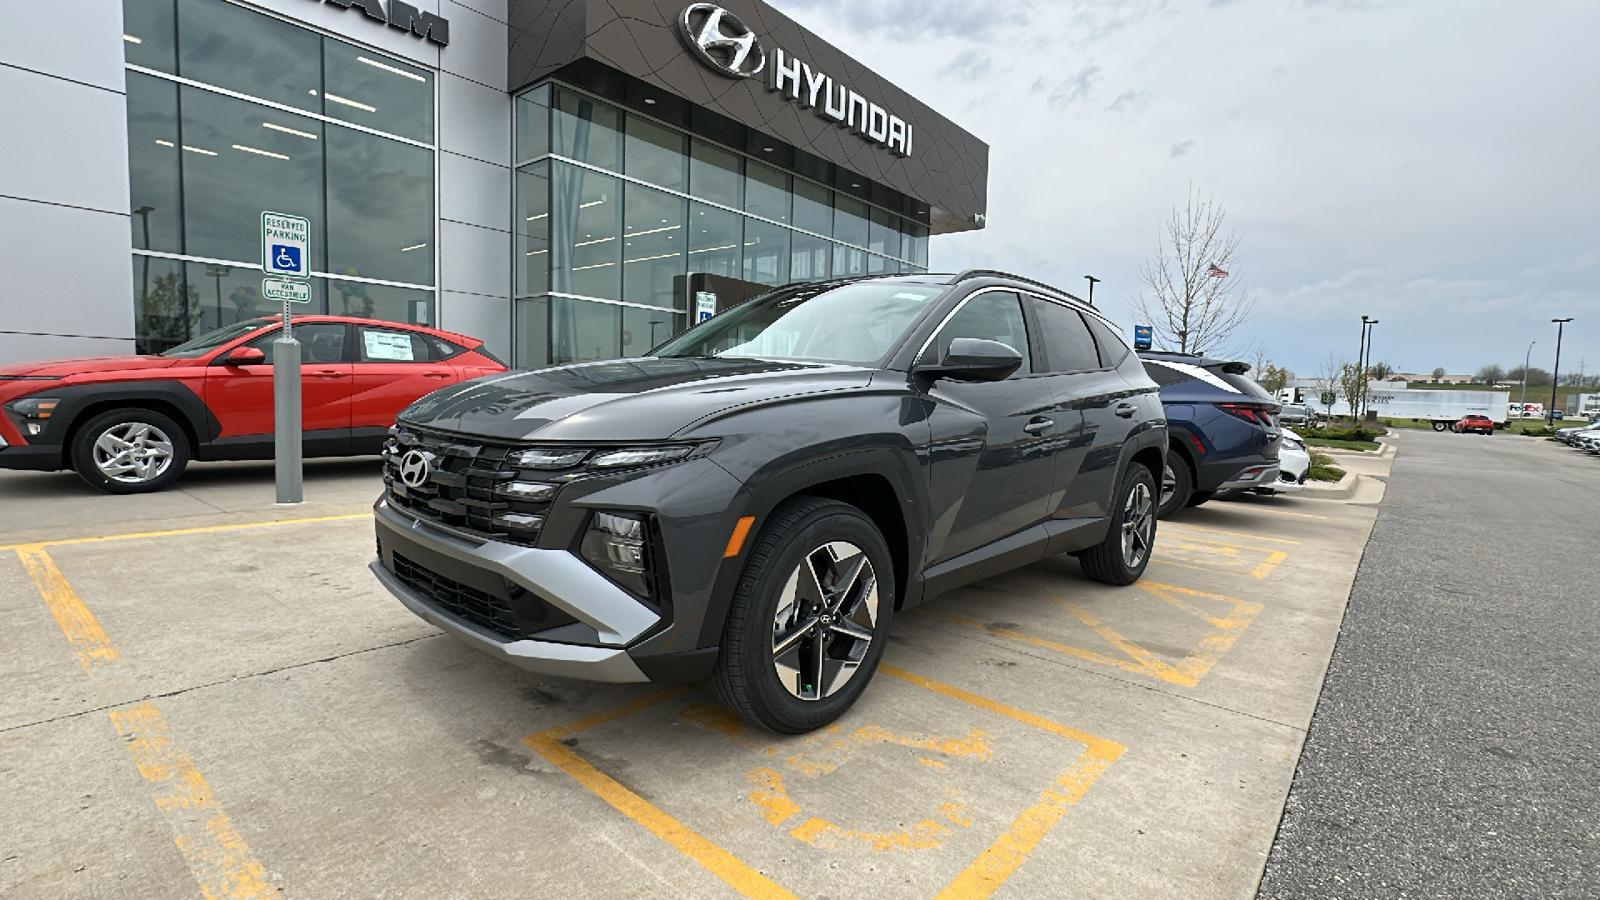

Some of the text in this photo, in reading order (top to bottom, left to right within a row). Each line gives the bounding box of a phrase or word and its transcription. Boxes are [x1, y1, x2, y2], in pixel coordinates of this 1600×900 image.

[310, 0, 449, 47] AM
[770, 48, 913, 157] HYUNDAI
[266, 218, 304, 231] RESERVED
[266, 228, 305, 242] PARKING
[267, 289, 307, 299] ACCESSIBLE
